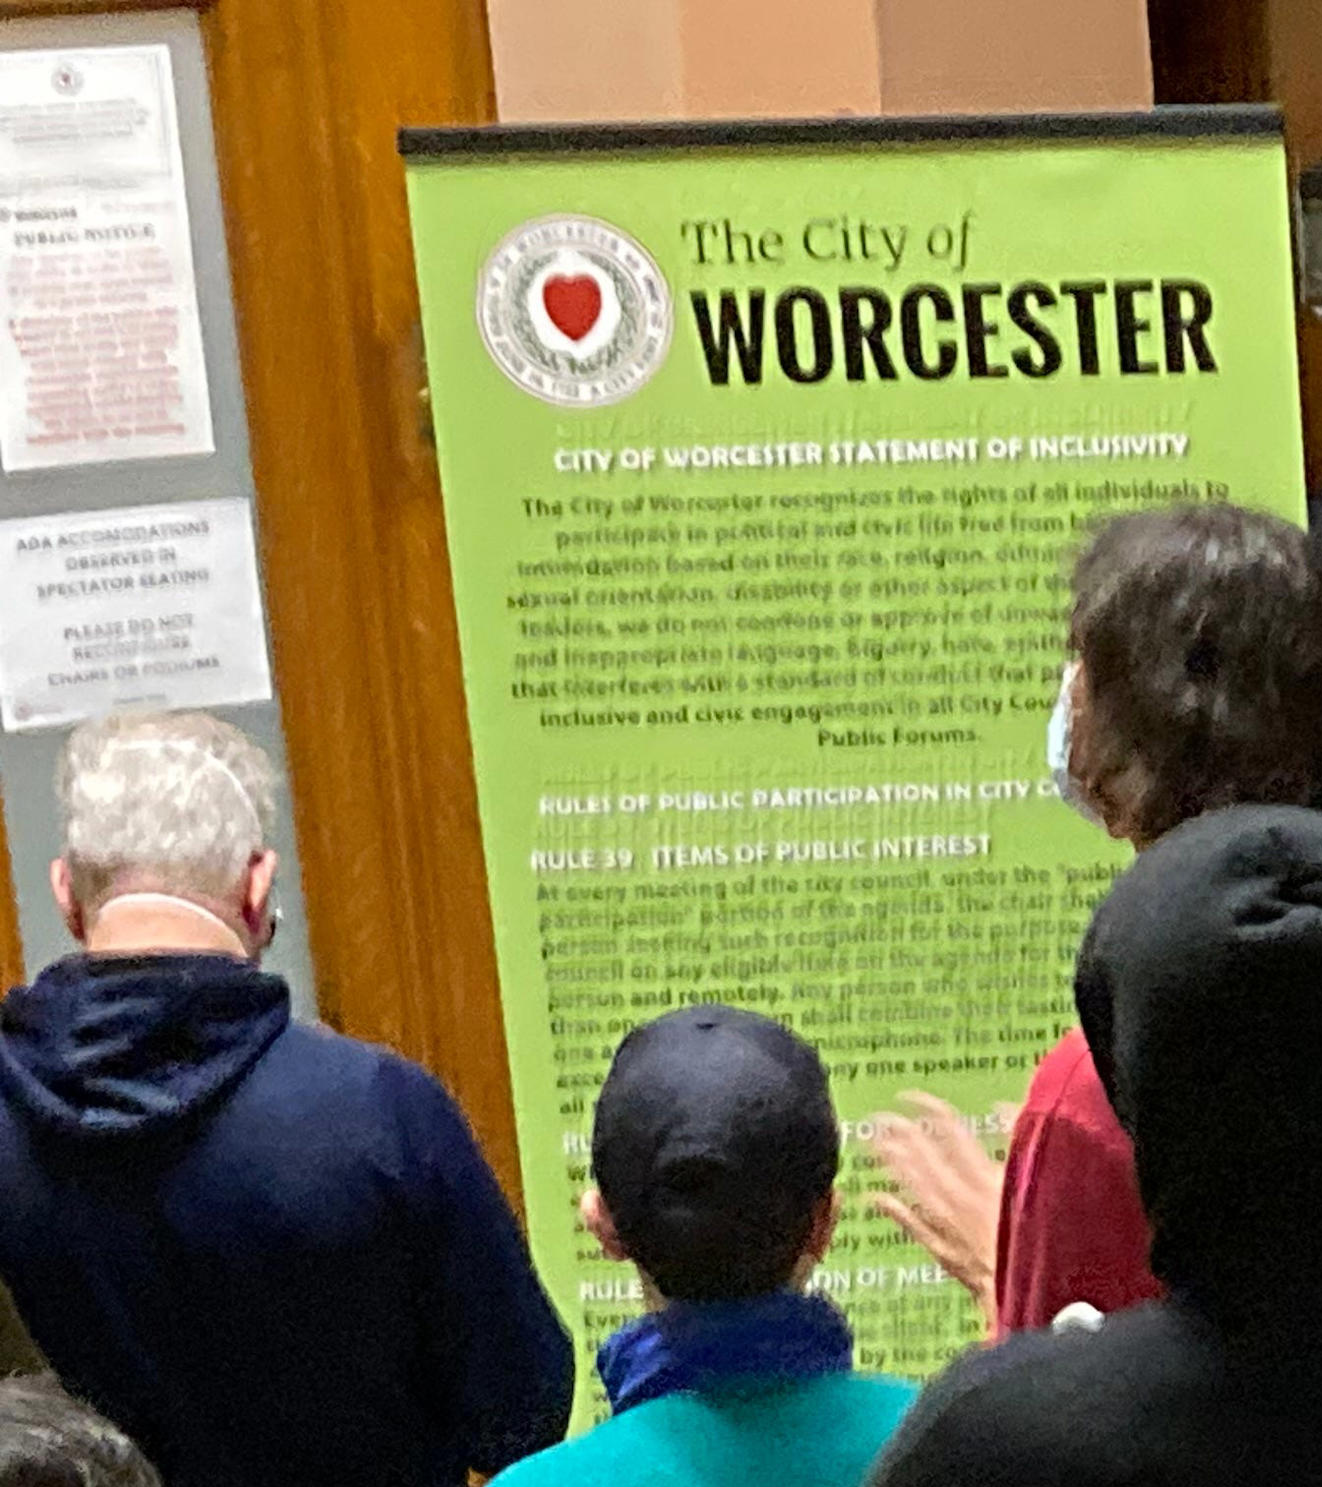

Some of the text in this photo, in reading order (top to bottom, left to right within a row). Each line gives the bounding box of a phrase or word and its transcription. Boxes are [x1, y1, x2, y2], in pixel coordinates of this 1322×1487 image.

[681, 209, 976, 273] The City of
[690, 277, 1219, 387] WORCESTER
[554, 432, 1189, 473] CITY OF WORCESTER STATEMENT OF INCLUSIVITY
[522, 479, 1229, 520] The City of Worcester recognizes the rights of all individuals to
[556, 524, 681, 549] participate
[687, 523, 708, 540] in
[714, 520, 807, 546] political
[1011, 510, 1064, 532] from
[16, 536, 53, 552] ADA
[37, 576, 134, 598] SPECTATOR
[63, 620, 123, 640] PLEASE
[512, 680, 558, 698] that
[540, 707, 641, 728] inclusive
[646, 704, 690, 724] and
[695, 704, 744, 724] civic
[751, 701, 894, 725] engagement
[928, 697, 953, 715] all
[959, 697, 1003, 716] City
[818, 725, 980, 747] Public Forums.
[540, 779, 1031, 816] RULES OF PUBLIC PARTICIPATION IN CITY
[531, 833, 991, 871] RULE 39 ITEMS OF PUBLIC INTEREST
[565, 885, 627, 905] every
[633, 880, 727, 902] meeting
[761, 874, 799, 894] the
[941, 866, 1008, 888] under
[1013, 864, 1051, 884] the
[630, 986, 672, 1006] and
[679, 984, 786, 1009] remotely.
[551, 1016, 602, 1035] than
[998, 1024, 1047, 1044] time
[865, 1060, 906, 1075] one
[912, 1053, 999, 1078] speaker
[1005, 1054, 1027, 1070] or
[560, 1098, 585, 1114] all
[580, 1279, 644, 1300] RULE
[857, 1267, 889, 1288] OF
